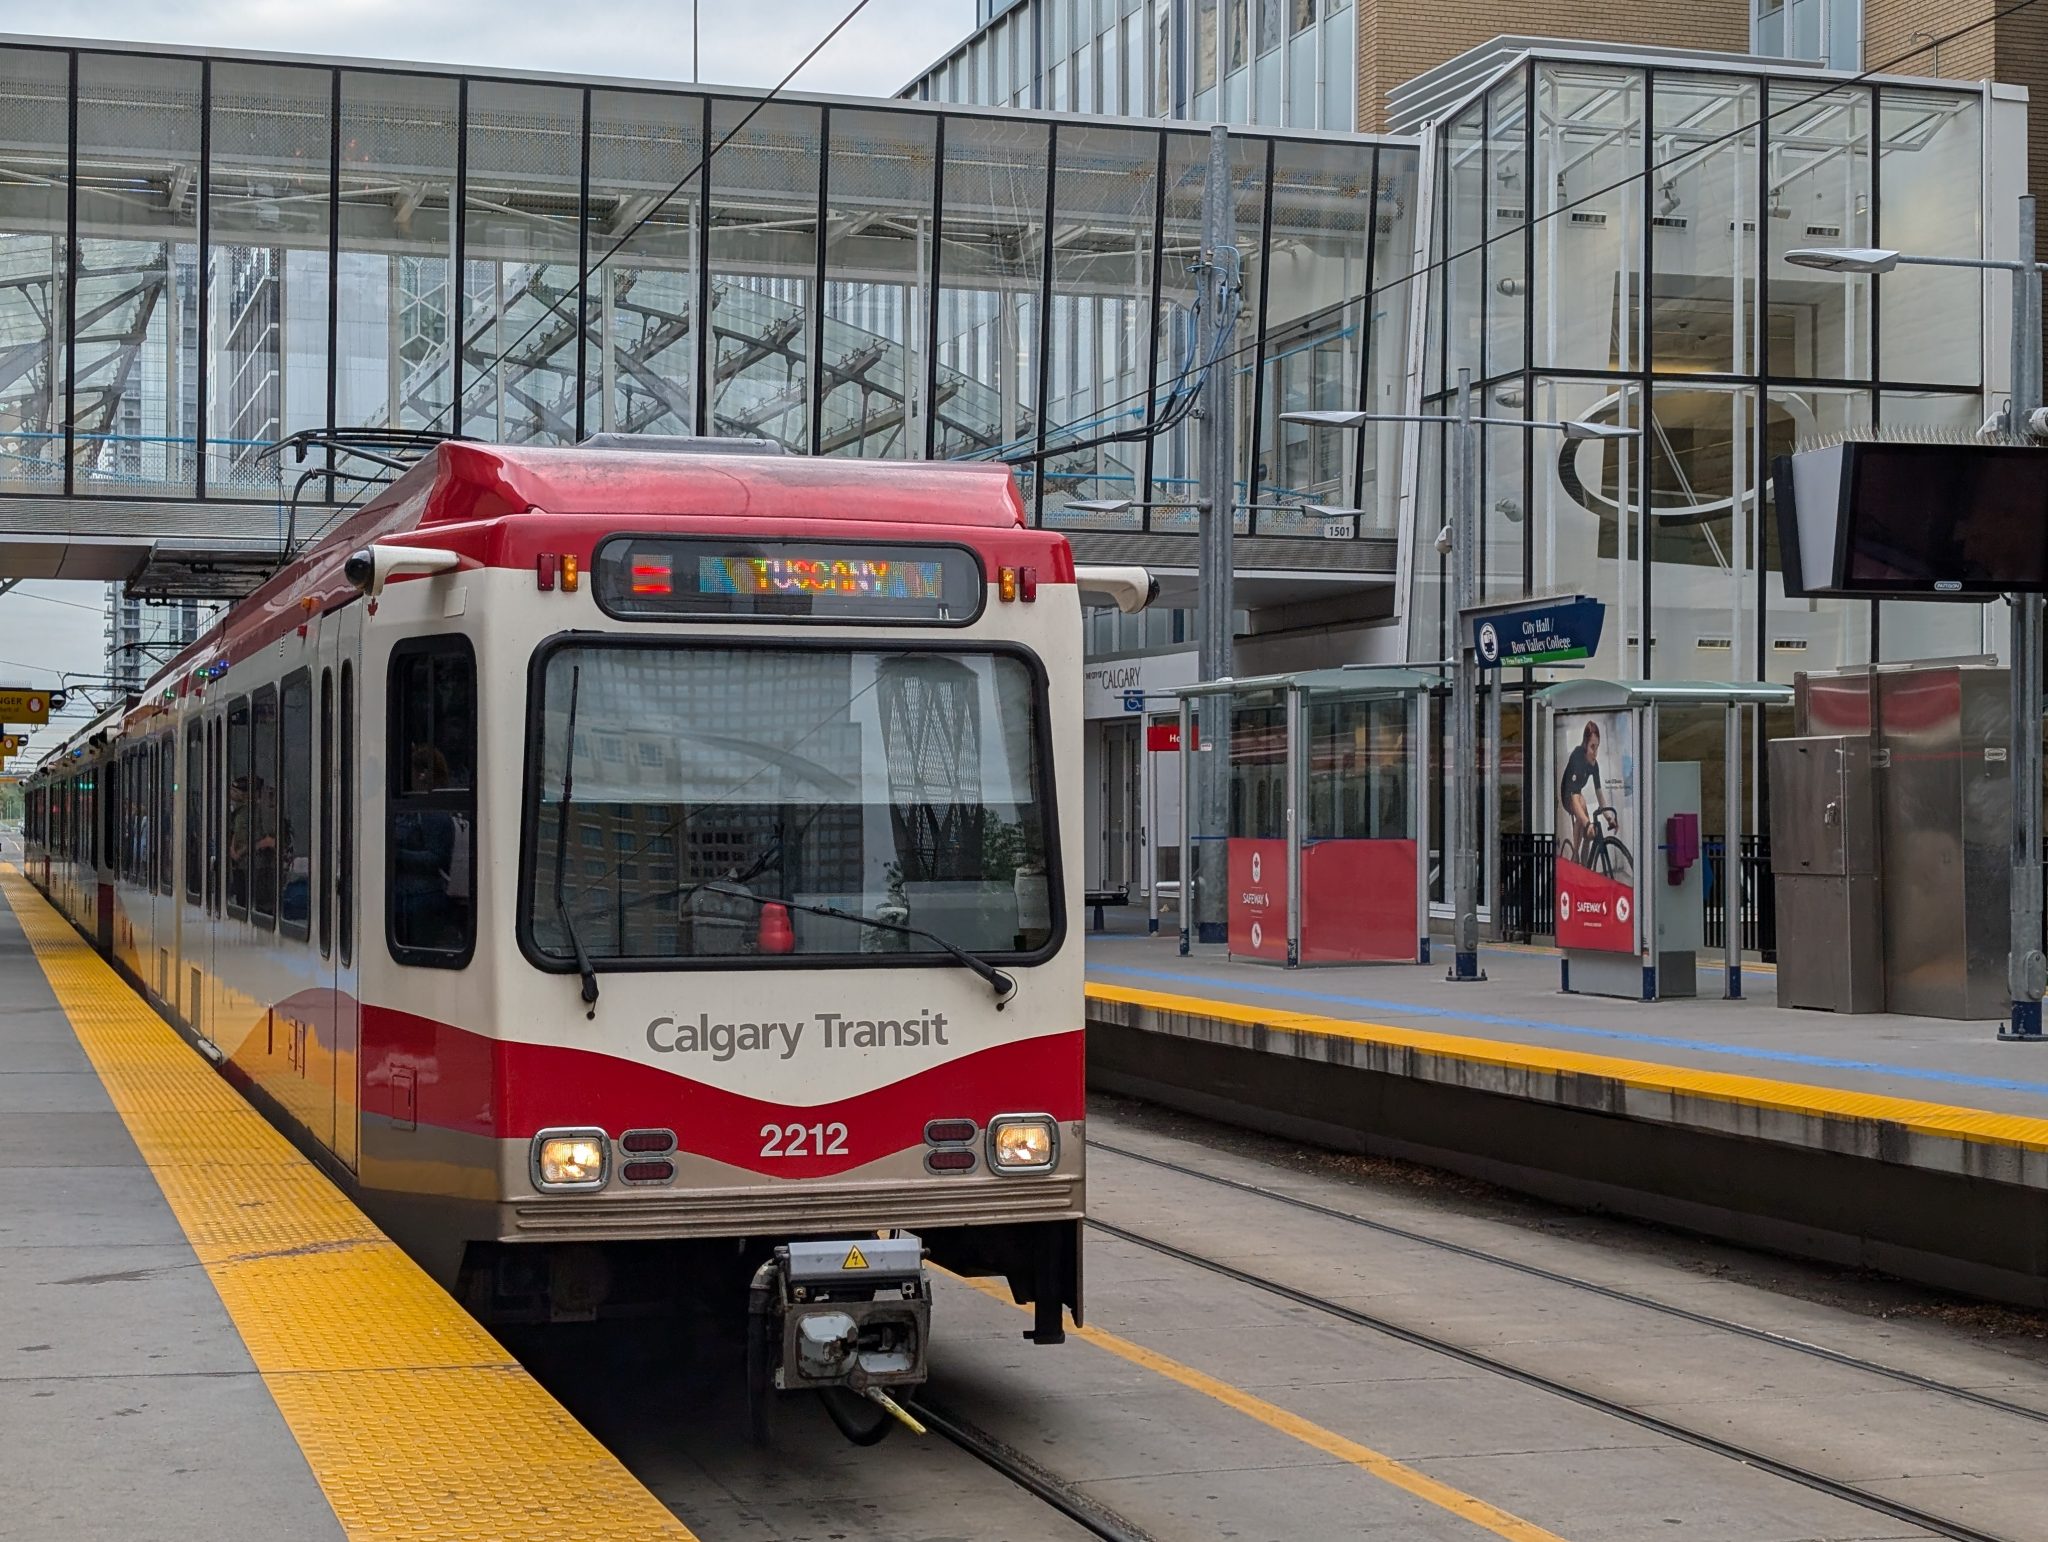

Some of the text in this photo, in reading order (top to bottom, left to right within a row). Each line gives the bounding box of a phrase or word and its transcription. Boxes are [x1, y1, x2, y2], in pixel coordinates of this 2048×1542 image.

[1329, 526, 1350, 537] 1501
[1522, 621, 1535, 637] City
[1536, 618, 1550, 633] Hall
[1511, 634, 1572, 654] Bow Valley College
[1102, 666, 1141, 690] CALGARY
[1242, 893, 1264, 904] SAFEWAY
[1577, 901, 1602, 913] SAFEWAY
[646, 1009, 949, 1062] Calgary Transit
[760, 1122, 849, 1157] 2212
